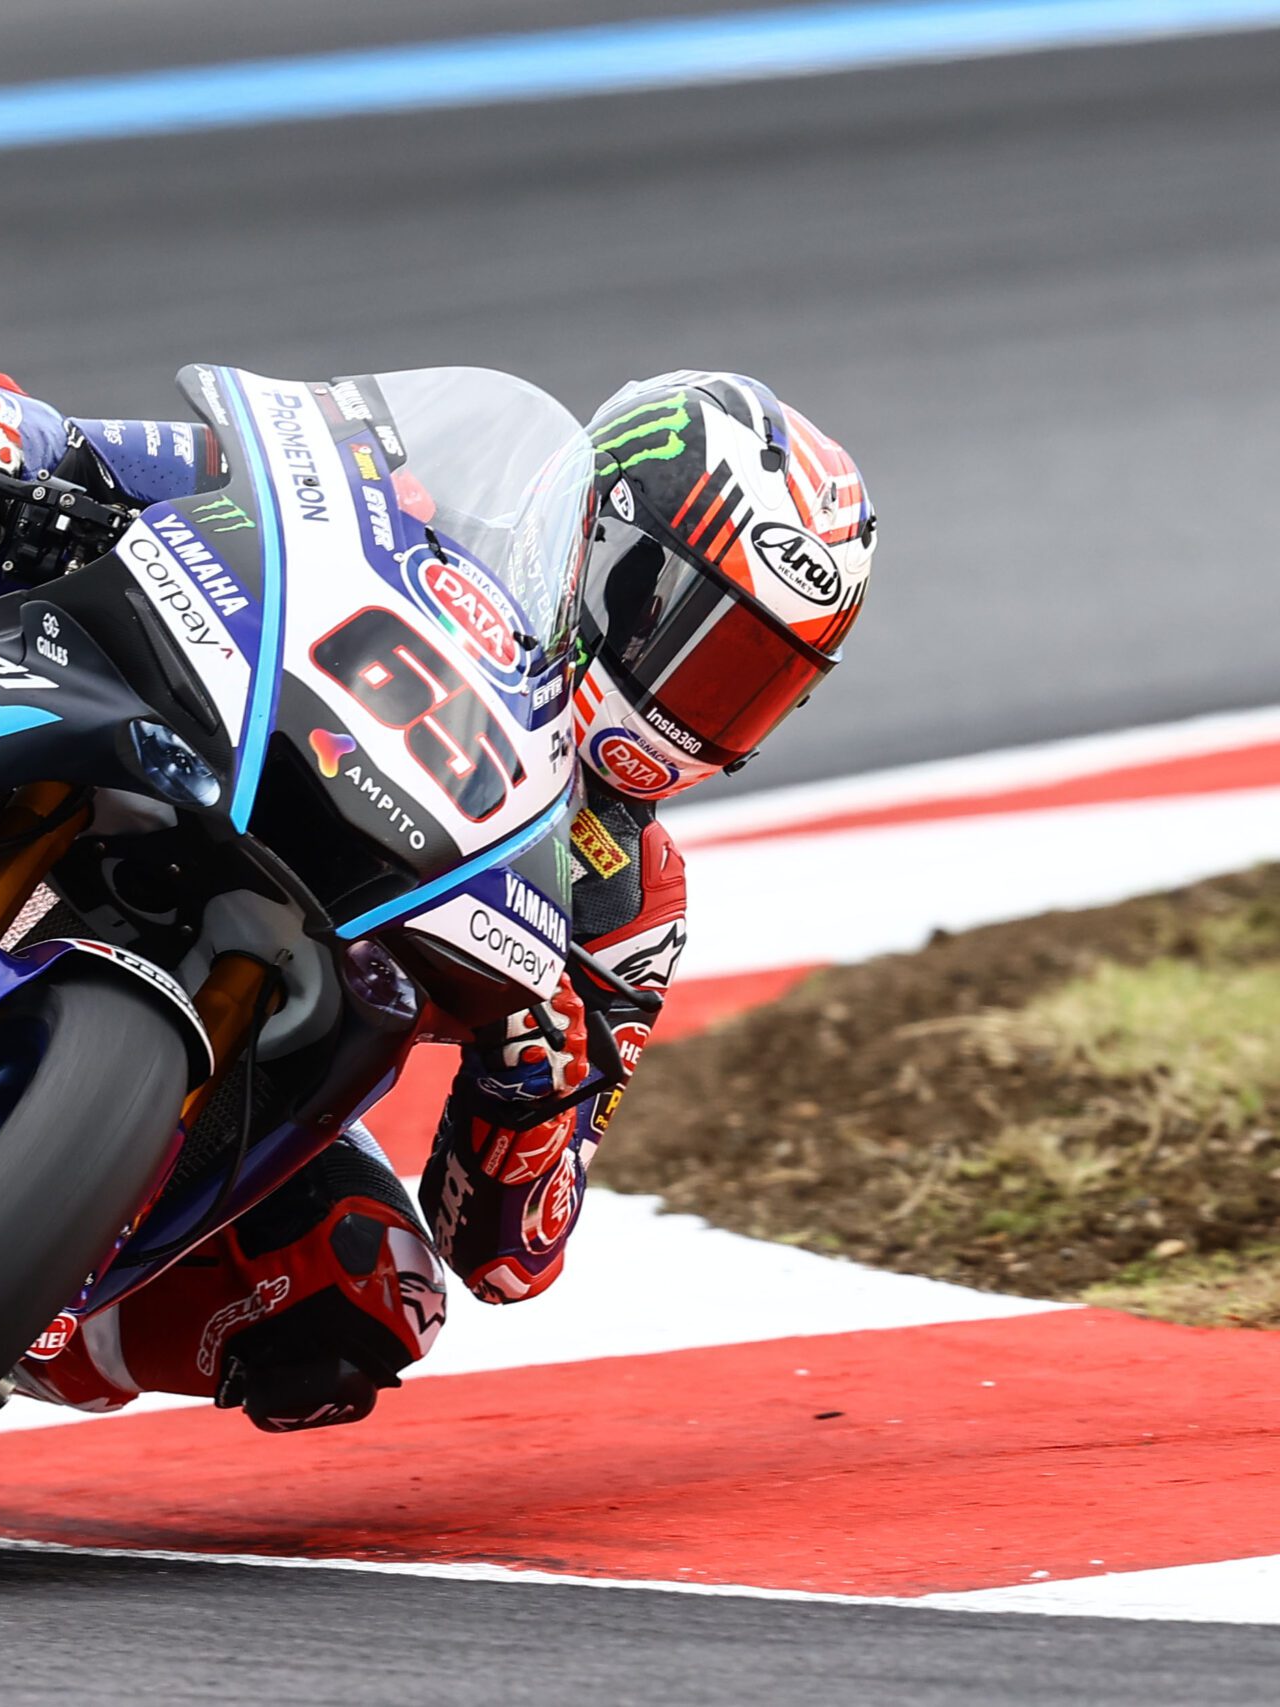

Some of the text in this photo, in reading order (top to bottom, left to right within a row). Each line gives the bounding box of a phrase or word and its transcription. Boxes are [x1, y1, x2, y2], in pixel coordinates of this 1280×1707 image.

[152, 514, 249, 616] YAMAHA
[460, 562, 510, 617] SNACK
[758, 532, 838, 596] Arai
[434, 571, 506, 657] PATA
[36, 636, 69, 667] GILLES
[309, 605, 526, 823] 65
[646, 707, 702, 755] Insta360
[606, 744, 659, 786] PATA
[344, 766, 426, 850] AMPITO
[505, 873, 567, 953] YAMAHA
[30, 1332, 69, 1350] HEL
